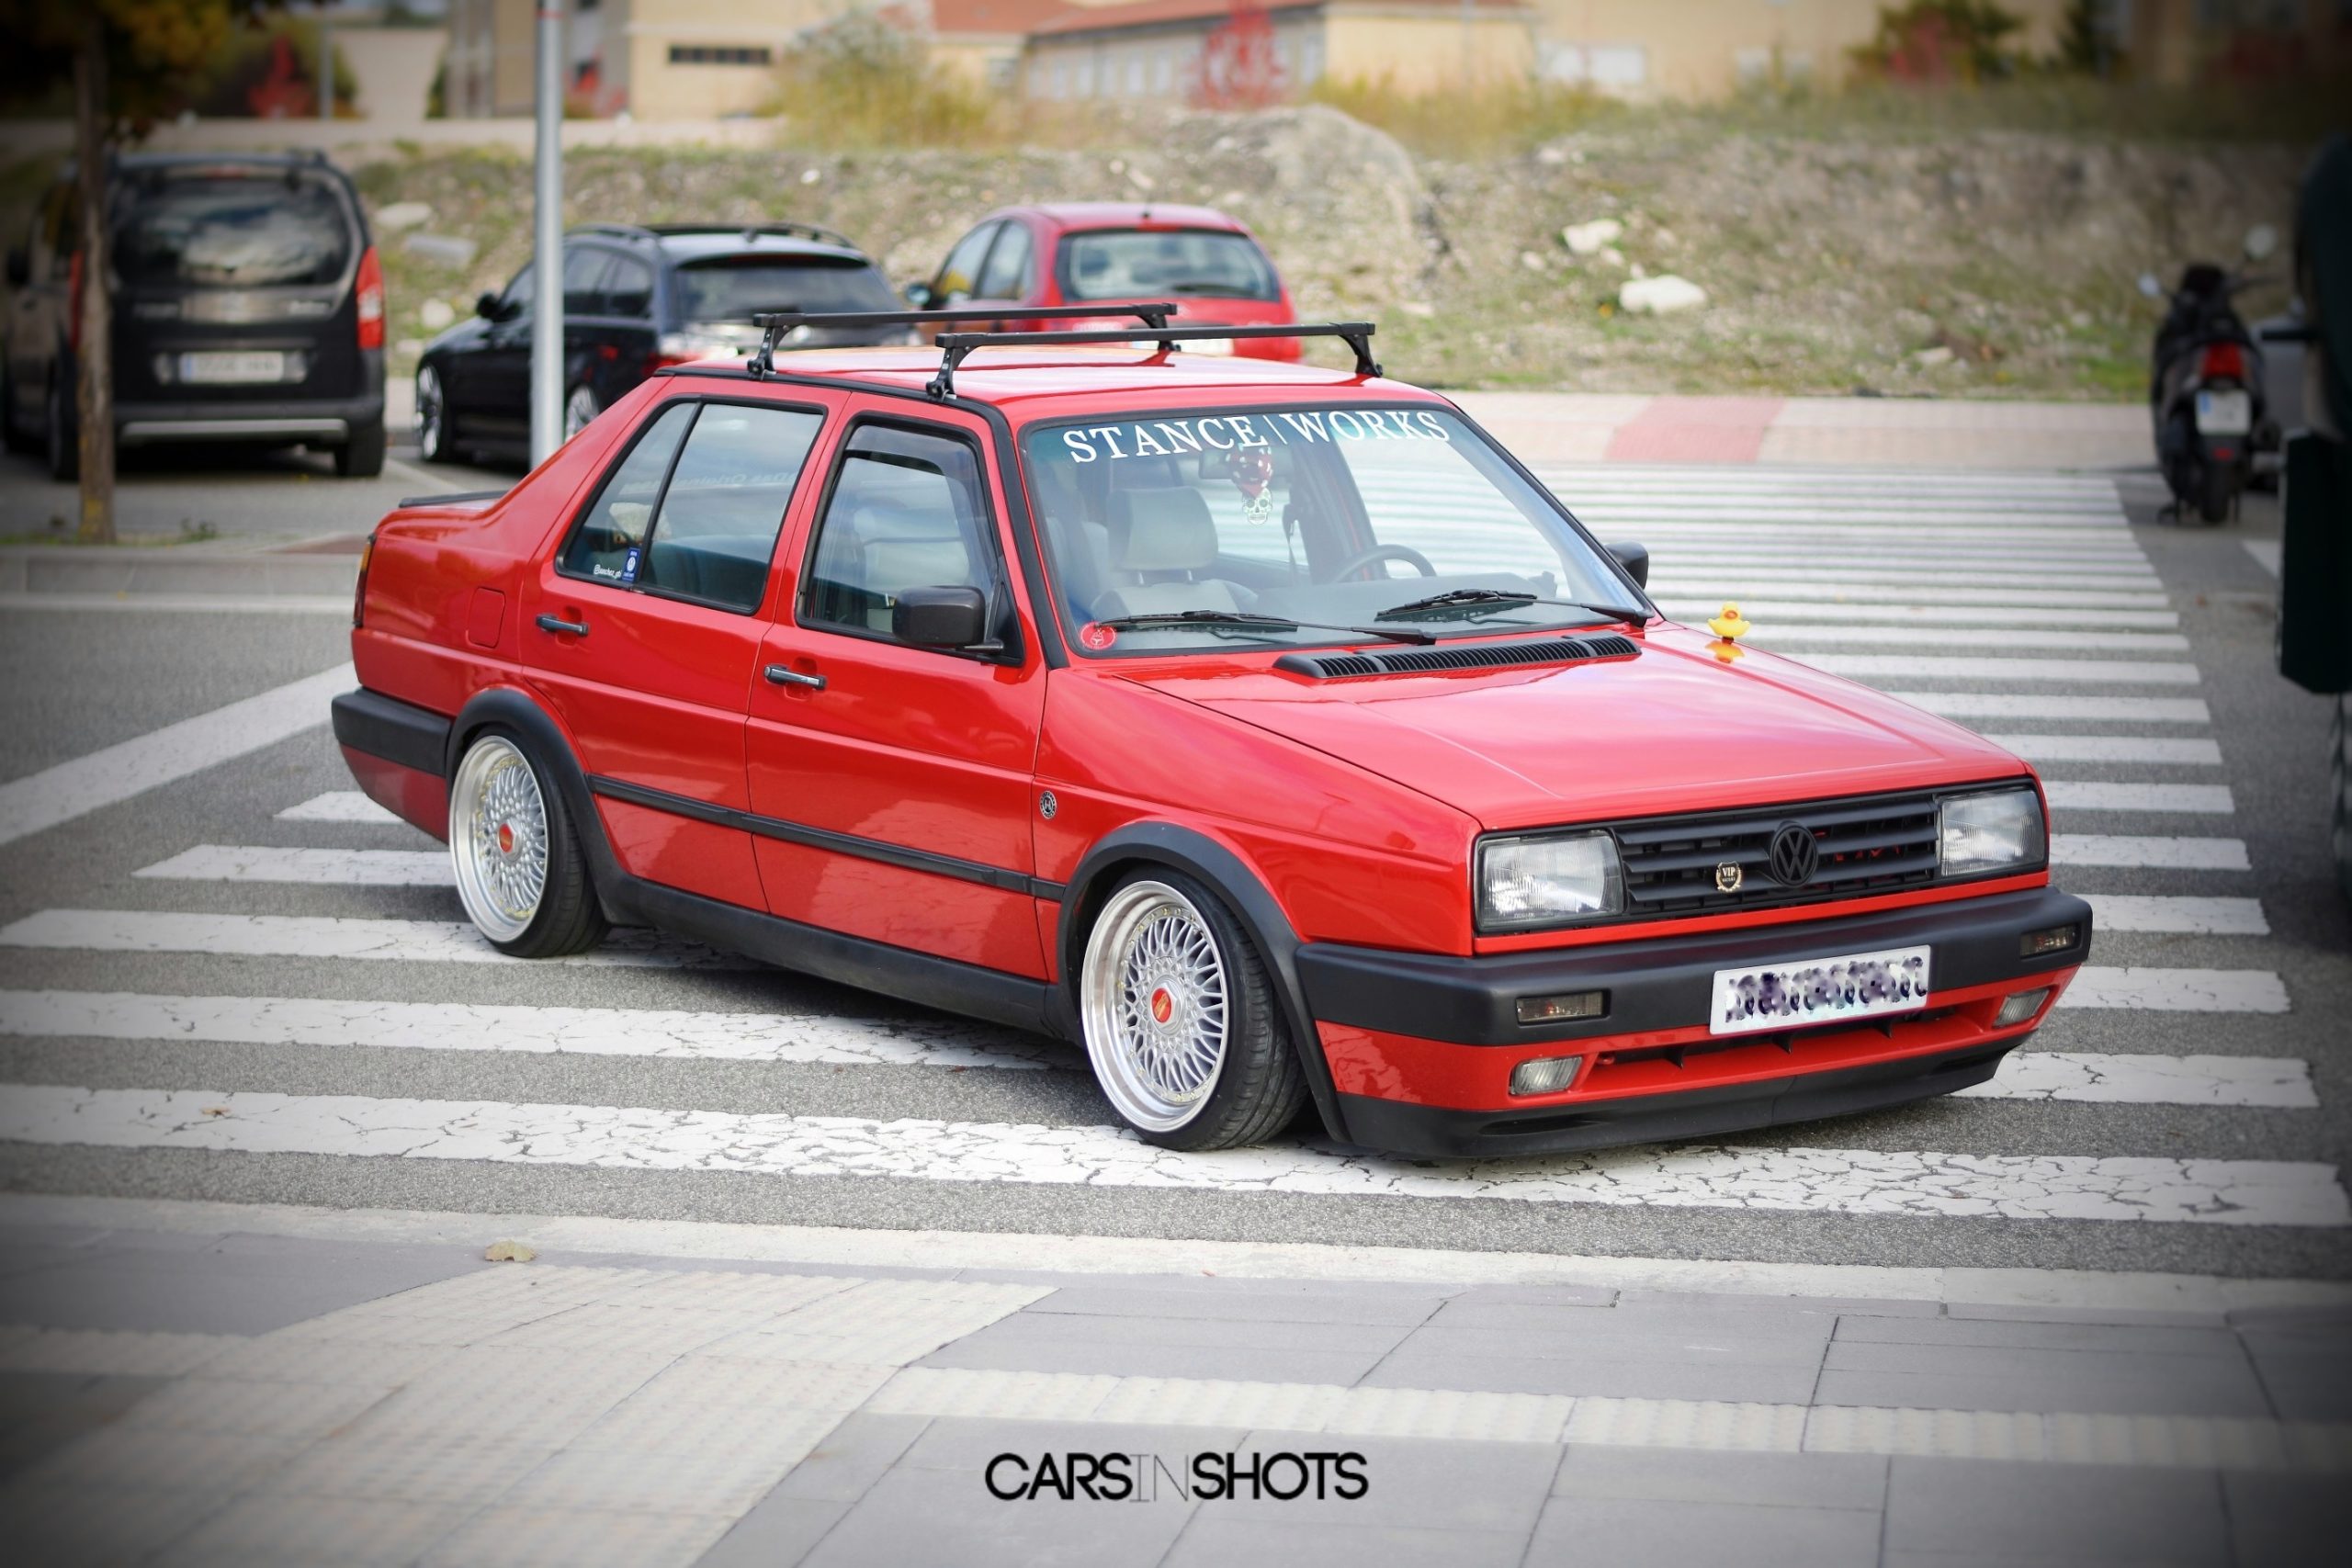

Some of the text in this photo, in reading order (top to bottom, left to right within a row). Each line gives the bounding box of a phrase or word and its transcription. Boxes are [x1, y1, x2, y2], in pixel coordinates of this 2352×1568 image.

[1063, 416, 1269, 463] STANCE
[1279, 410, 1450, 442] WORKS
[1722, 866, 1736, 877] VIP
